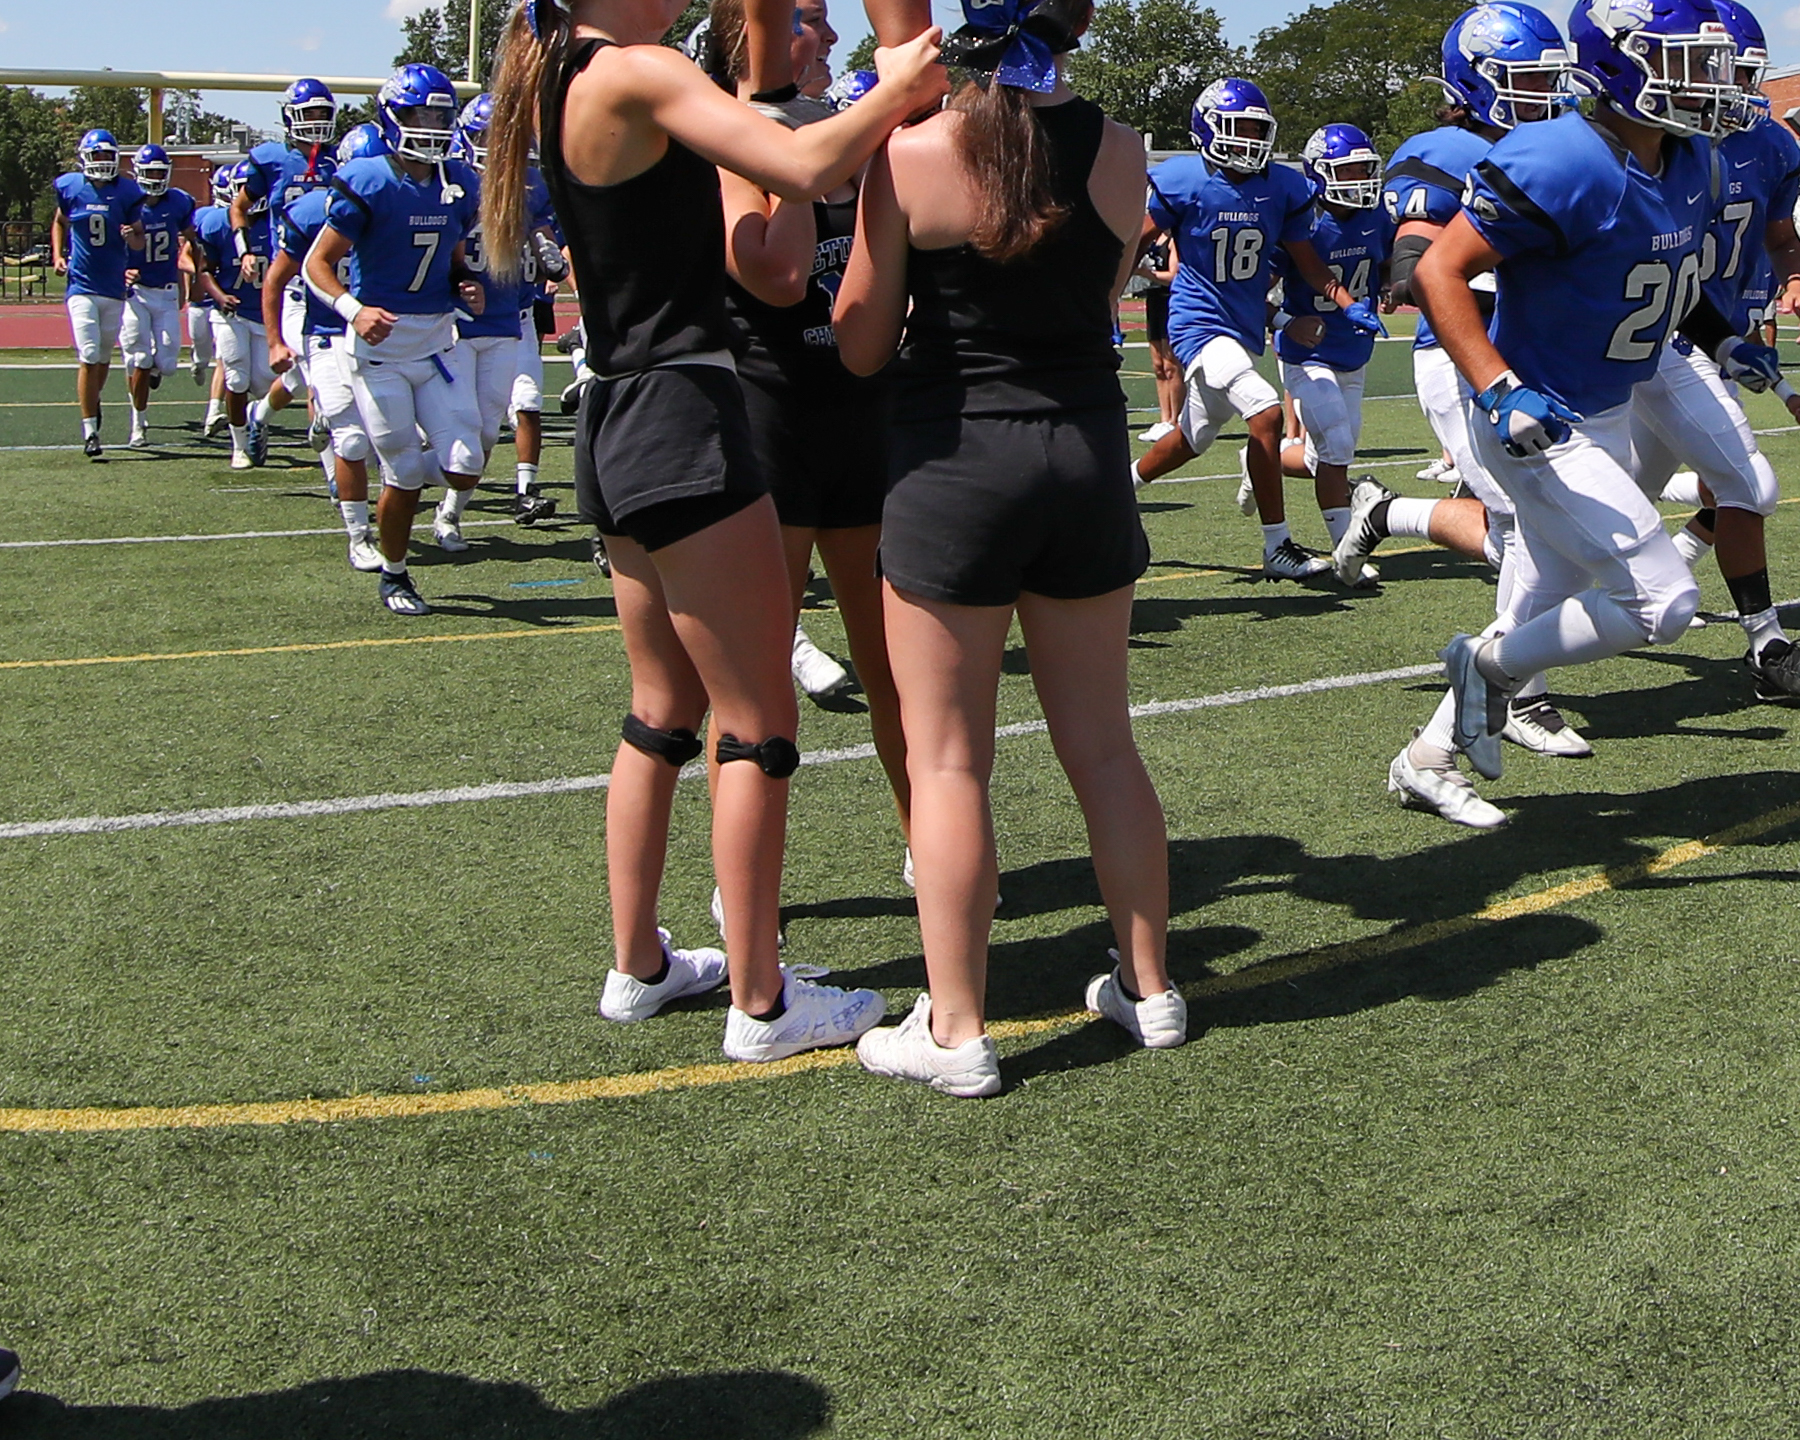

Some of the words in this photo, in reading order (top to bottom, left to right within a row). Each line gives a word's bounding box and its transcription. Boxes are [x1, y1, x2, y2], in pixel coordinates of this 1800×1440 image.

[88, 213, 106, 248] 9
[408, 214, 449, 226] BULLDOGS
[144, 230, 169, 263] 12
[407, 231, 441, 293] 7
[1210, 227, 1265, 284] 18
[1605, 252, 1701, 360] 20
